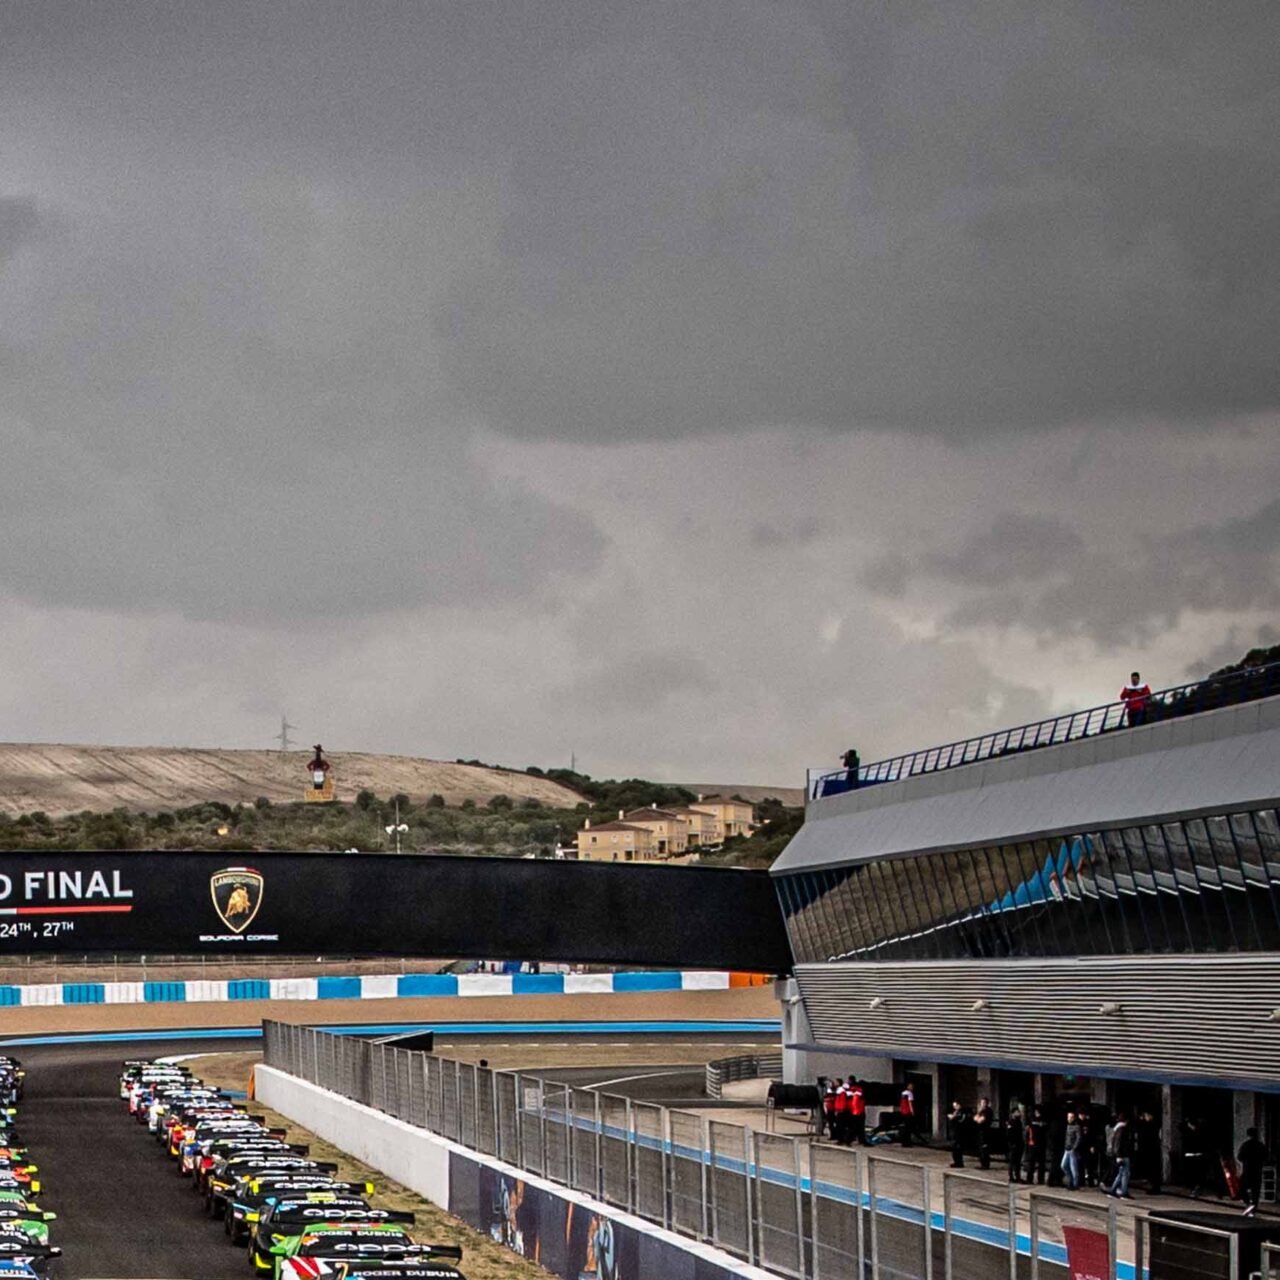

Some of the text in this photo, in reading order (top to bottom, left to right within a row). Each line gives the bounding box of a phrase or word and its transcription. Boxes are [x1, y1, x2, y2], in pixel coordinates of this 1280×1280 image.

[24, 870, 133, 900] FINAL
[43, 921, 74, 937] 27TH
[334, 1243, 432, 1252] oppo
[406, 1270, 459, 1278] DUBUIS
